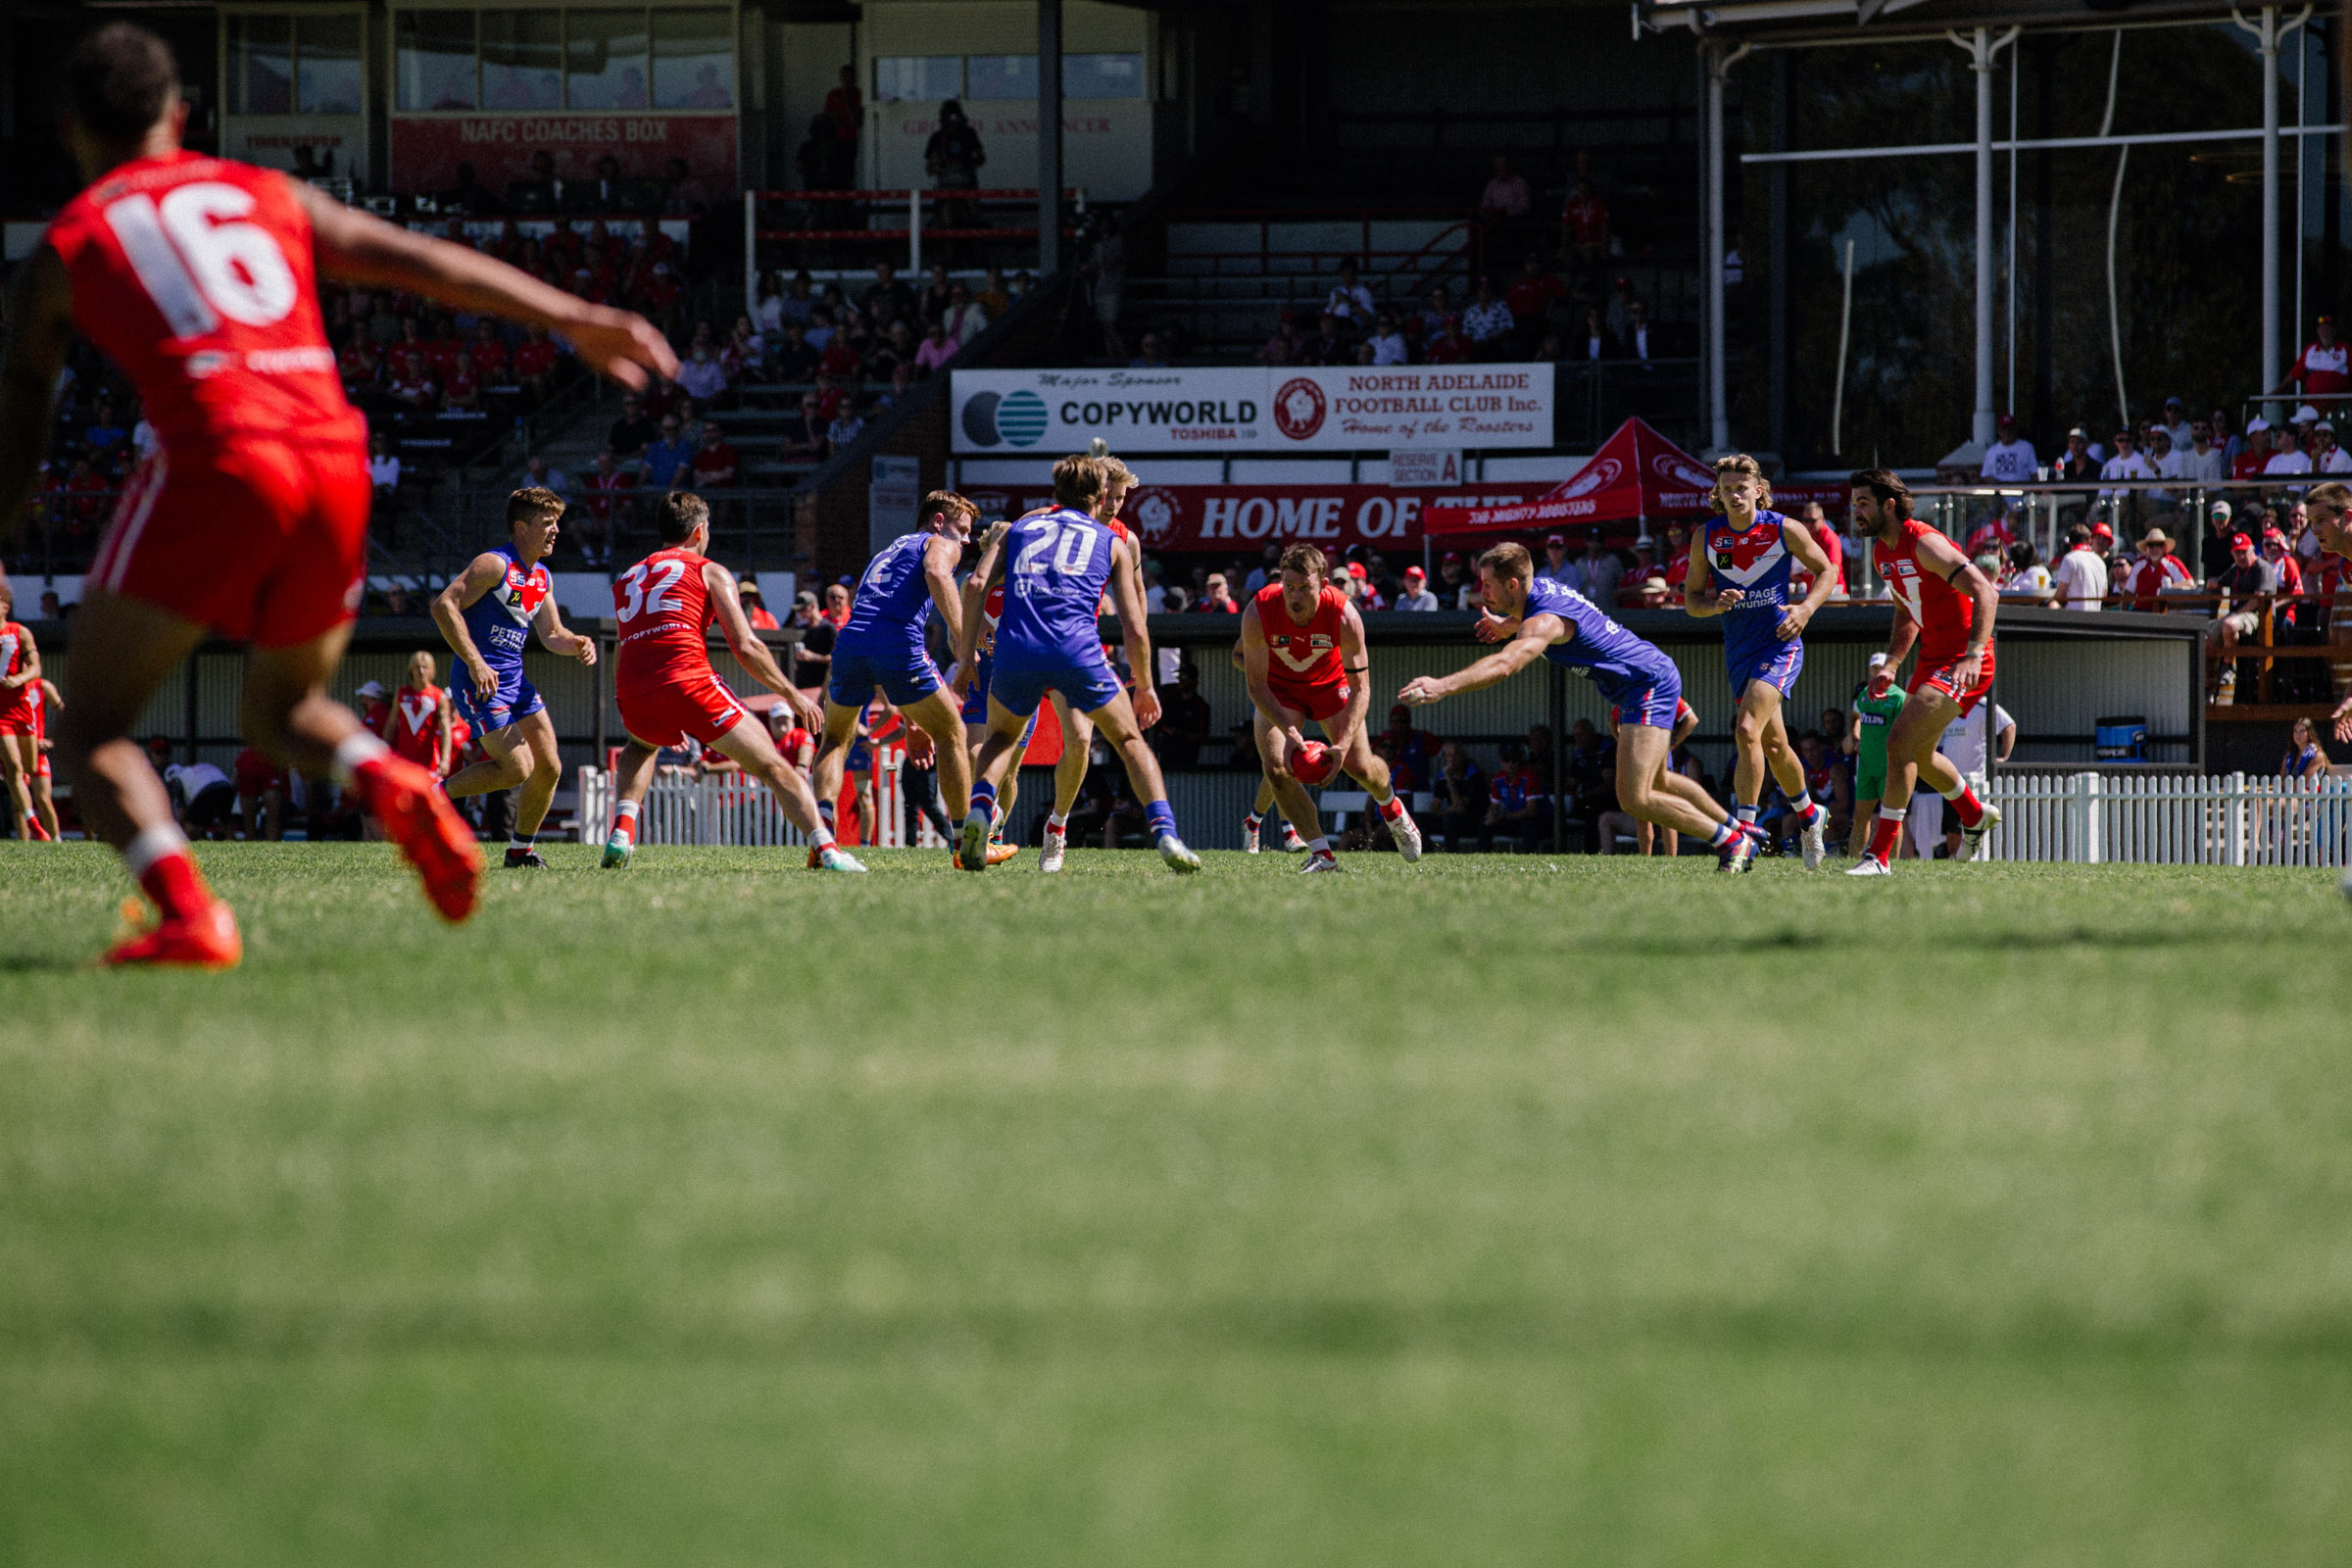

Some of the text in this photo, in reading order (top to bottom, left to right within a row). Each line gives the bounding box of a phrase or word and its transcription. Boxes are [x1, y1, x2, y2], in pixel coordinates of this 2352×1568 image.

[461, 121, 666, 141] NAFC COACHES BOX
[995, 118, 1110, 133] ANNNCER
[104, 180, 299, 343] 16
[1039, 371, 1182, 389] Major Sponsor
[1348, 373, 1530, 392] NORTH ADELAIDE
[1061, 401, 1257, 424] COPYWORLD
[1335, 395, 1543, 414] FOOTBALL CLUB Inc.
[1170, 427, 1238, 440] TOSHIBA
[1341, 416, 1534, 438] Home of the Roosters
[1394, 454, 1437, 466] RESERVE
[1442, 454, 1458, 481] A
[1393, 468, 1438, 482] SECTION
[1199, 497, 1346, 538] HOME
[1356, 496, 1421, 538] OF
[1014, 519, 1099, 576] 20
[617, 559, 686, 623] 32
[1748, 587, 1778, 600] PAGE
[490, 624, 523, 644] PETER
